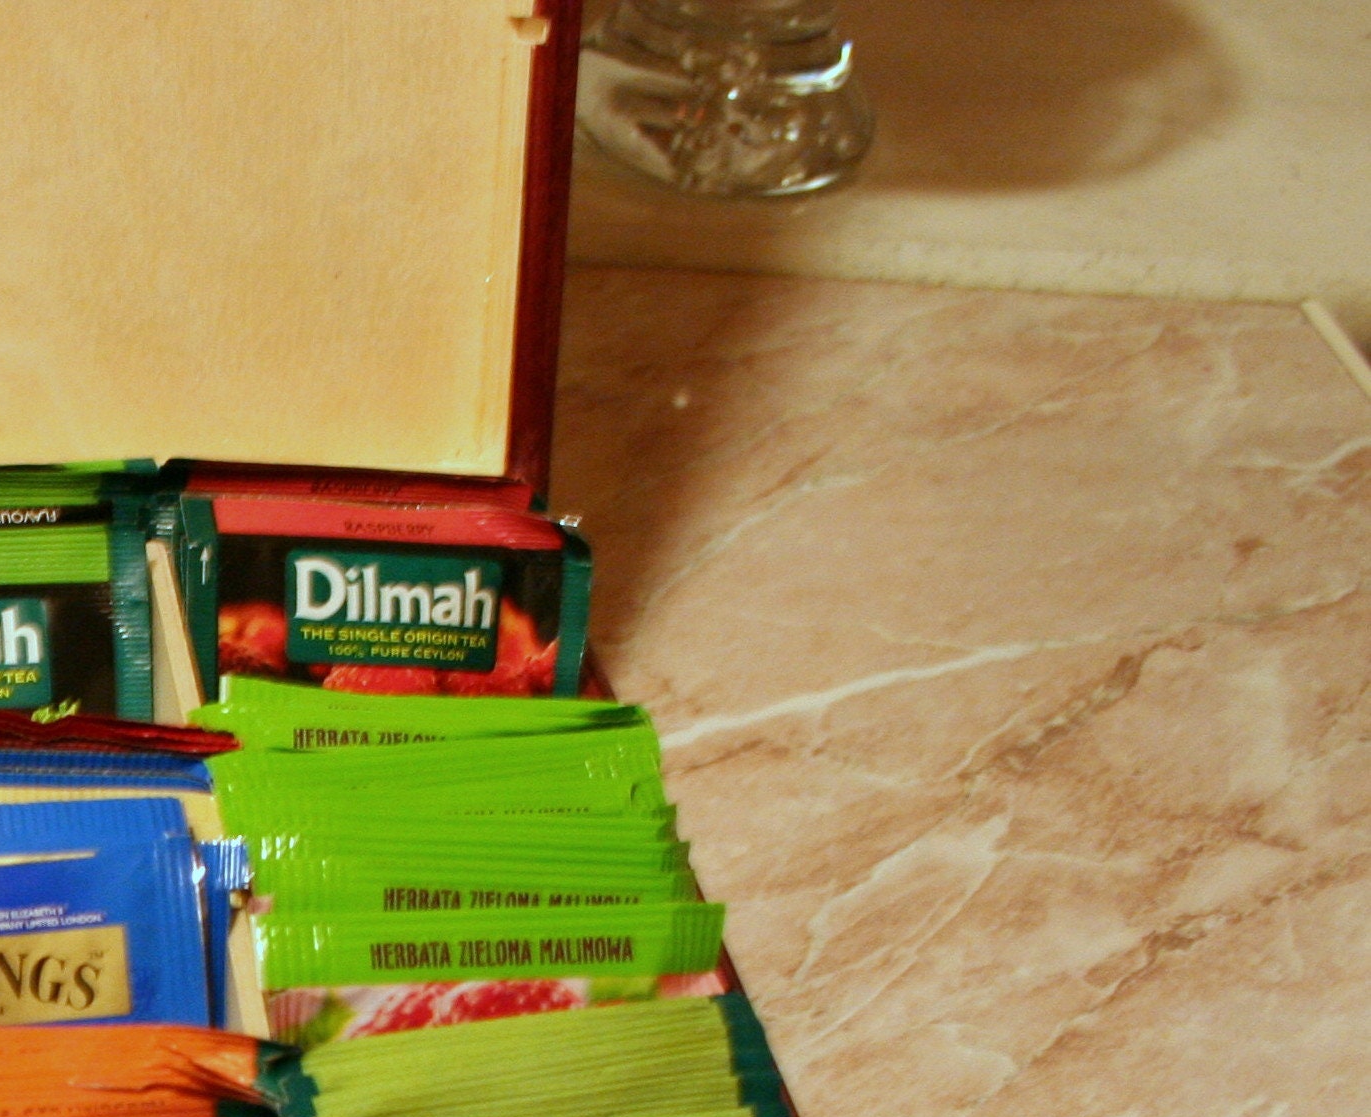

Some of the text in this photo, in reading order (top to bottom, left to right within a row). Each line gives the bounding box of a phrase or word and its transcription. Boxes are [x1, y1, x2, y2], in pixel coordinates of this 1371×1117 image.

[293, 557, 497, 630] Dilmah
[300, 626, 488, 649] THE SINGLE ORIGIN TEA
[370, 645, 412, 659] PURE
[413, 647, 466, 661] CEYLON
[2, 669, 40, 685] TEA
[370, 935, 635, 970] HERBATA ZIELONA MALINOWA
